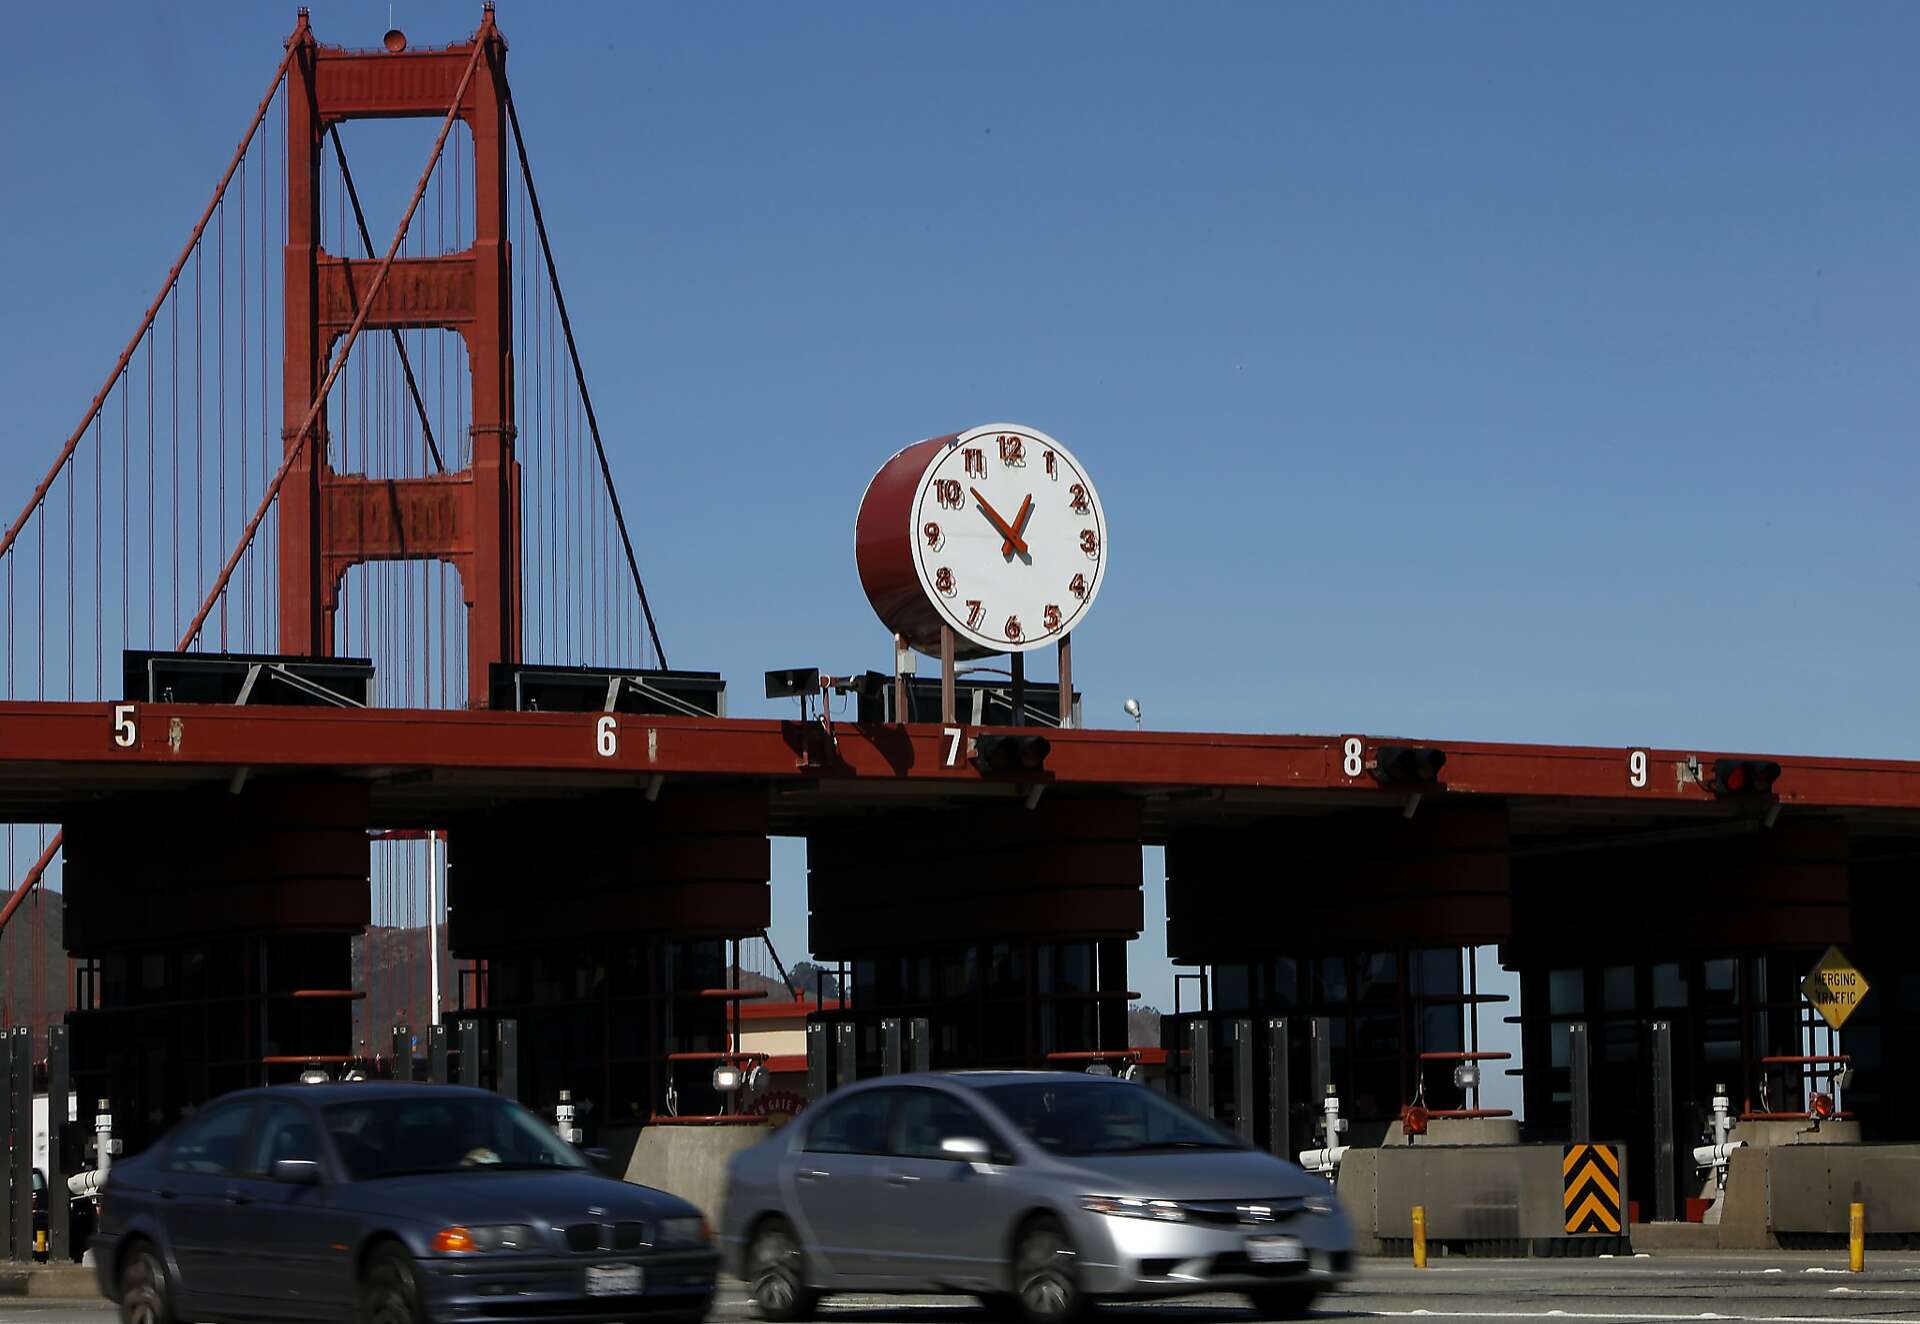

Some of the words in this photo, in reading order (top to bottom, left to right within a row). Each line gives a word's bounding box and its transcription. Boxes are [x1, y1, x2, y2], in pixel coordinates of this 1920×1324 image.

[961, 448, 984, 474] 11
[996, 435, 1023, 461] 12
[1042, 450, 1055, 475] 1
[933, 479, 962, 504] 10
[1069, 483, 1088, 509] 2
[924, 522, 941, 546] 9
[1079, 528, 1097, 554] 3
[936, 567, 954, 593] 8
[1069, 573, 1086, 595] 4
[966, 600, 982, 626] 7
[1043, 604, 1062, 629] 5
[1004, 615, 1022, 639] 6
[115, 704, 136, 748] 5
[597, 715, 617, 757] 6
[944, 727, 961, 766] 7
[1344, 737, 1362, 777] 8
[1630, 750, 1647, 788] 9
[1814, 972, 1856, 986] MERGING
[1816, 991, 1856, 1005] TRAFFIC
